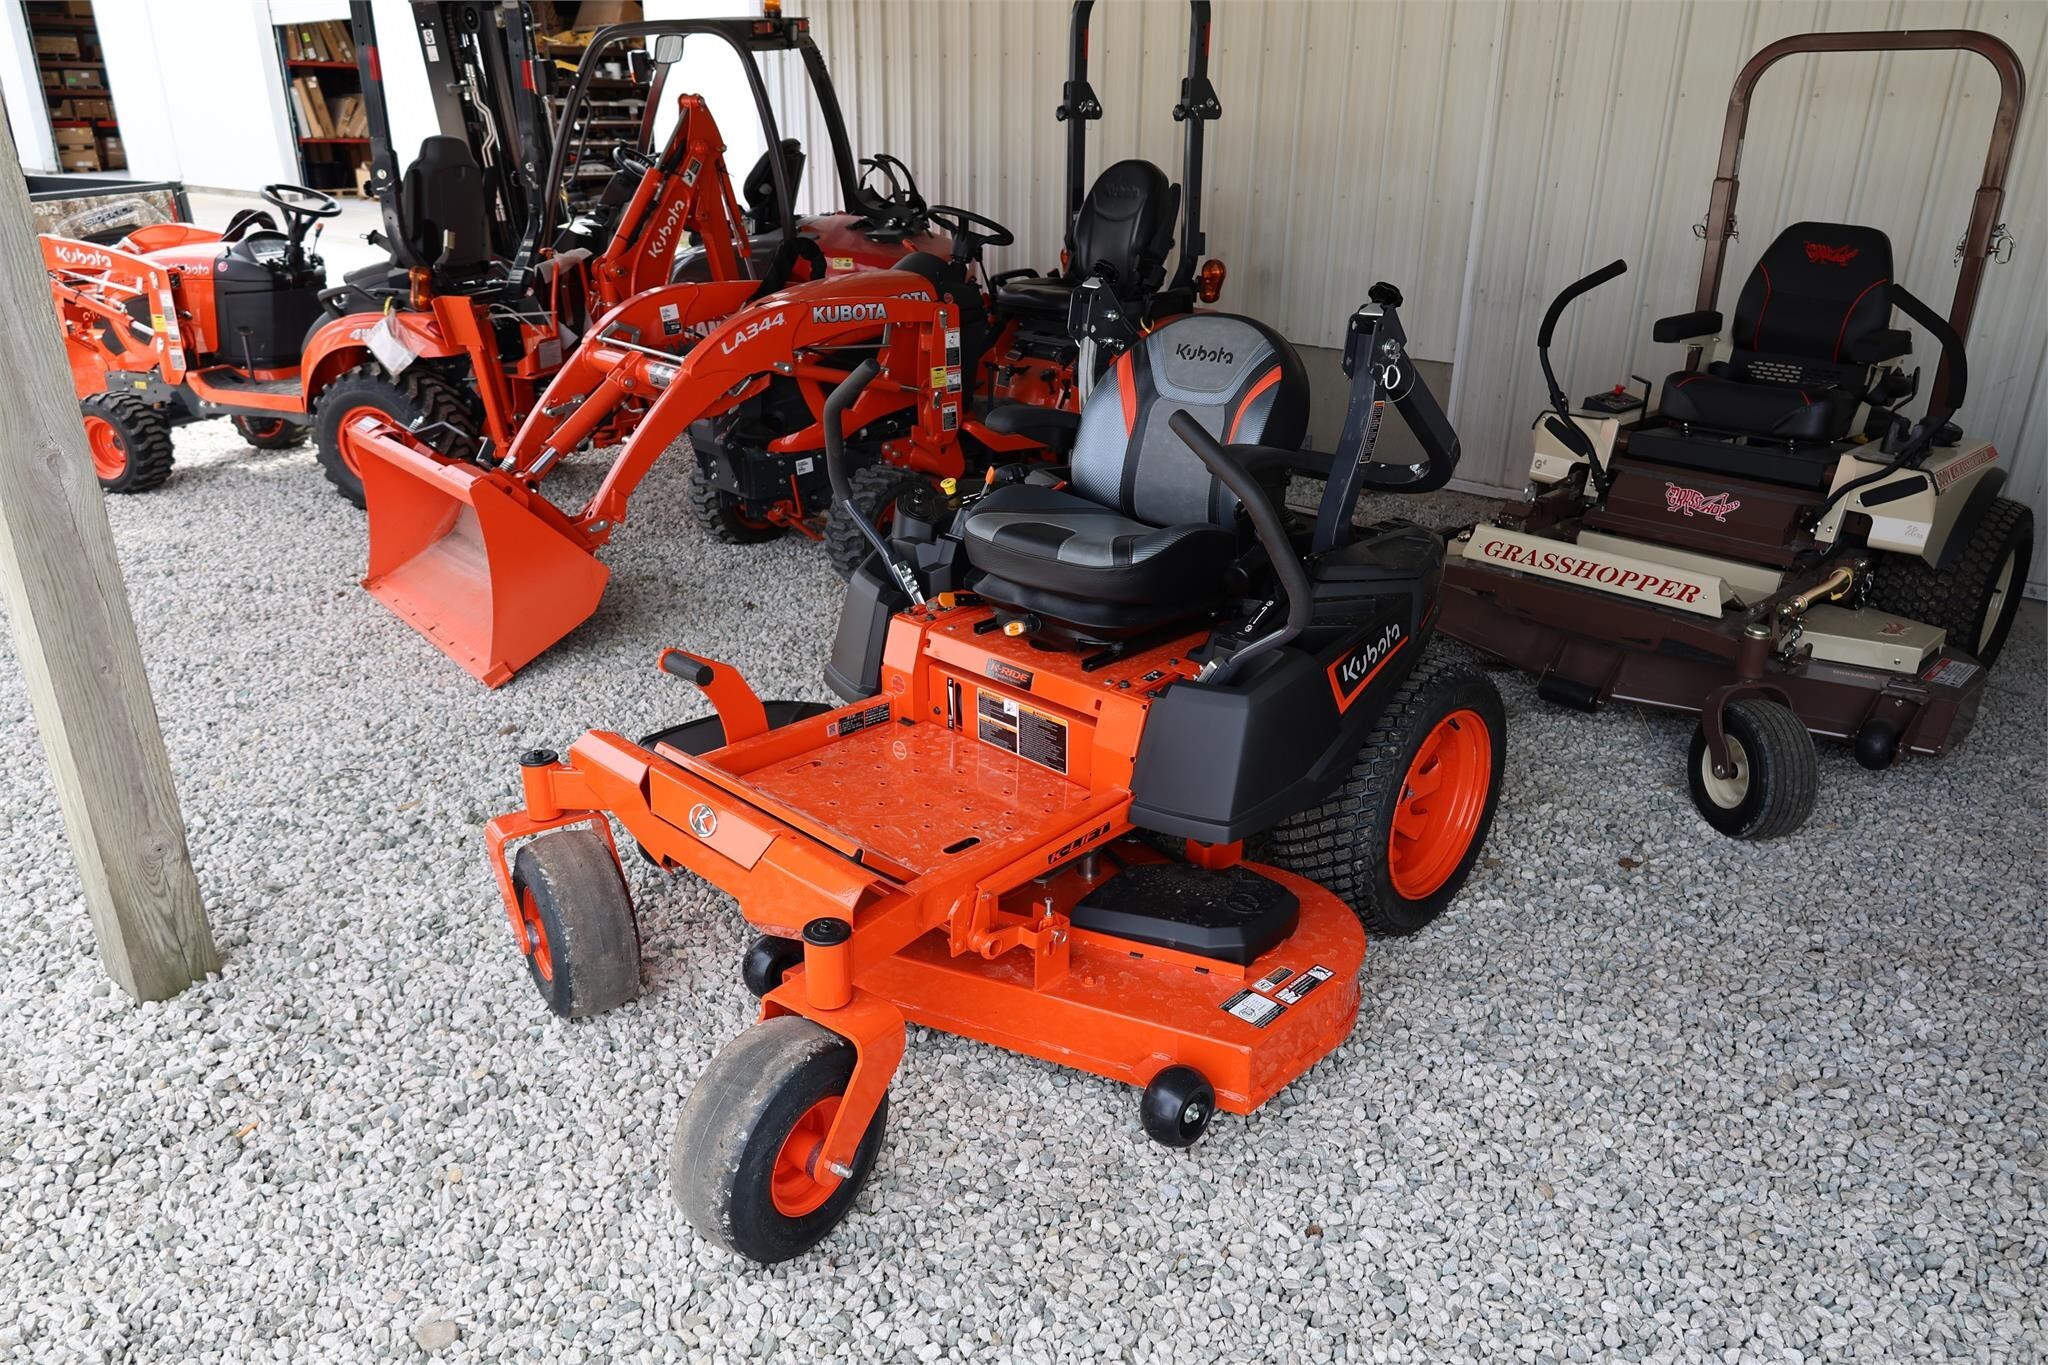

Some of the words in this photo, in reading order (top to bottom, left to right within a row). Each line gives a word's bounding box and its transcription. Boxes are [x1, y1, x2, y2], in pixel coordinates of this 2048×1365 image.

[85, 206, 134, 226] SIDEKICK
[647, 200, 685, 257] Kubota
[55, 246, 112, 268] Kubota
[812, 303, 887, 324] KUBOTA
[720, 312, 785, 355] LA344
[1175, 343, 1234, 364] Kubota
[1484, 540, 1701, 603] GRASSHOPPER
[1342, 623, 1400, 682] Kubota
